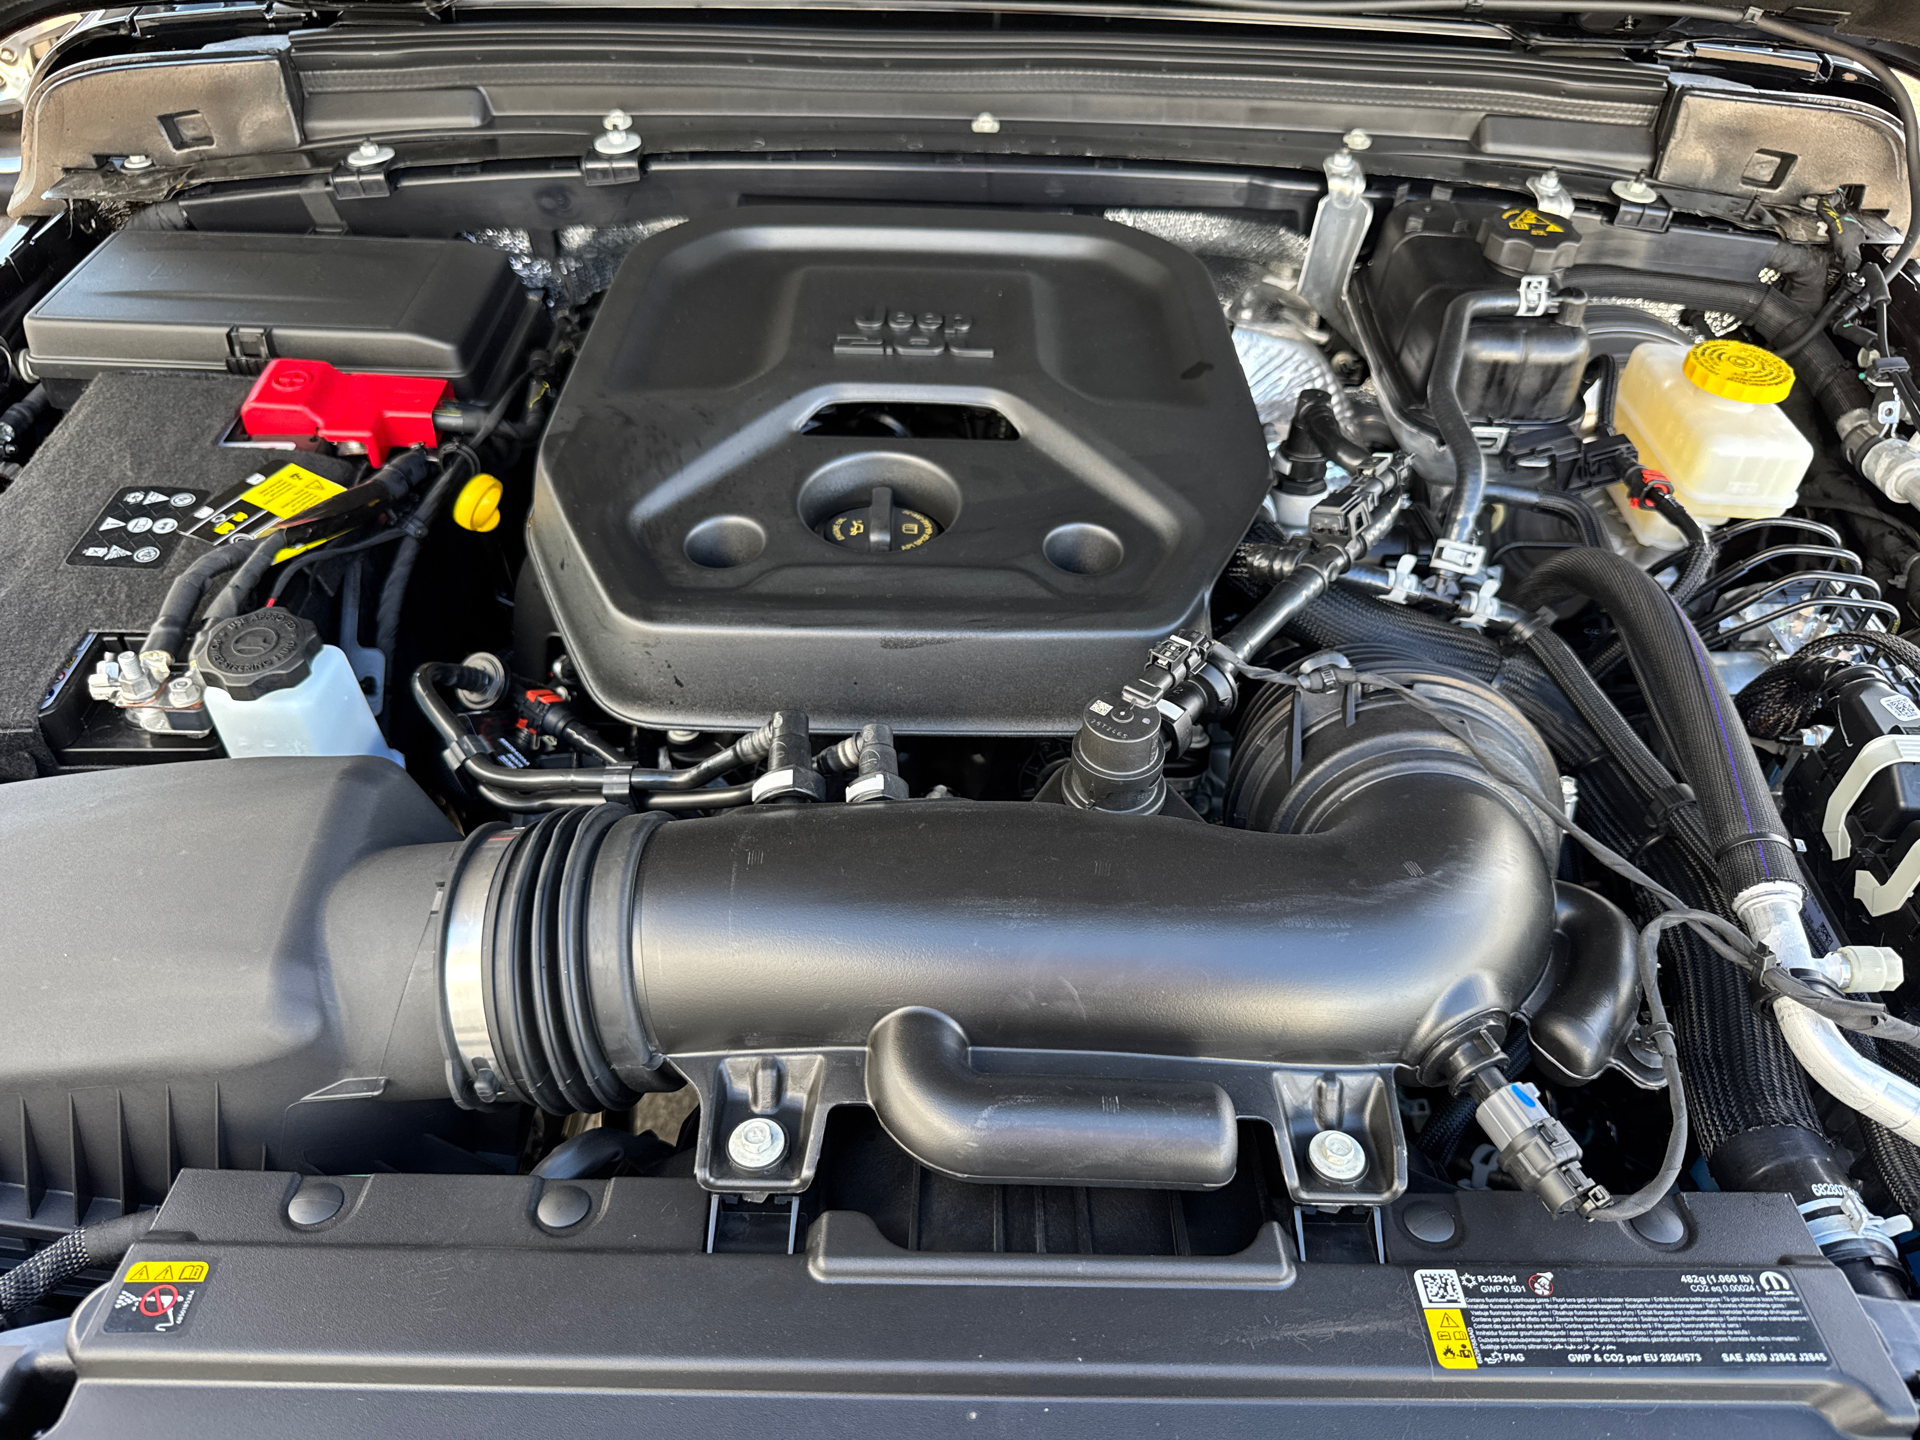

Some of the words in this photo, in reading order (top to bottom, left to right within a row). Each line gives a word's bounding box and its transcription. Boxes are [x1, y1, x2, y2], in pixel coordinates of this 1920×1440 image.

[854, 306, 973, 334] Jeep
[833, 334, 994, 358] 2.0L
[1680, 1274, 1706, 1285] 482g
[1707, 1274, 1738, 1284] (1.060
[1738, 1274, 1755, 1284] lb)
[1480, 1285, 1502, 1293] GWP
[1503, 1285, 1526, 1293] 0.501
[1690, 1284, 1710, 1293] CO2
[1711, 1286, 1722, 1294] eq
[1723, 1284, 1755, 1293] 0.00024
[1503, 1352, 1525, 1362] PAG
[1567, 1353, 1592, 1362] GWP
[1593, 1353, 1602, 1362] &
[1602, 1353, 1625, 1362] CO2
[1626, 1354, 1642, 1364] per
[1643, 1353, 1659, 1362] EU
[1660, 1353, 1702, 1362] 2024/573
[1721, 1352, 1744, 1362] SAE
